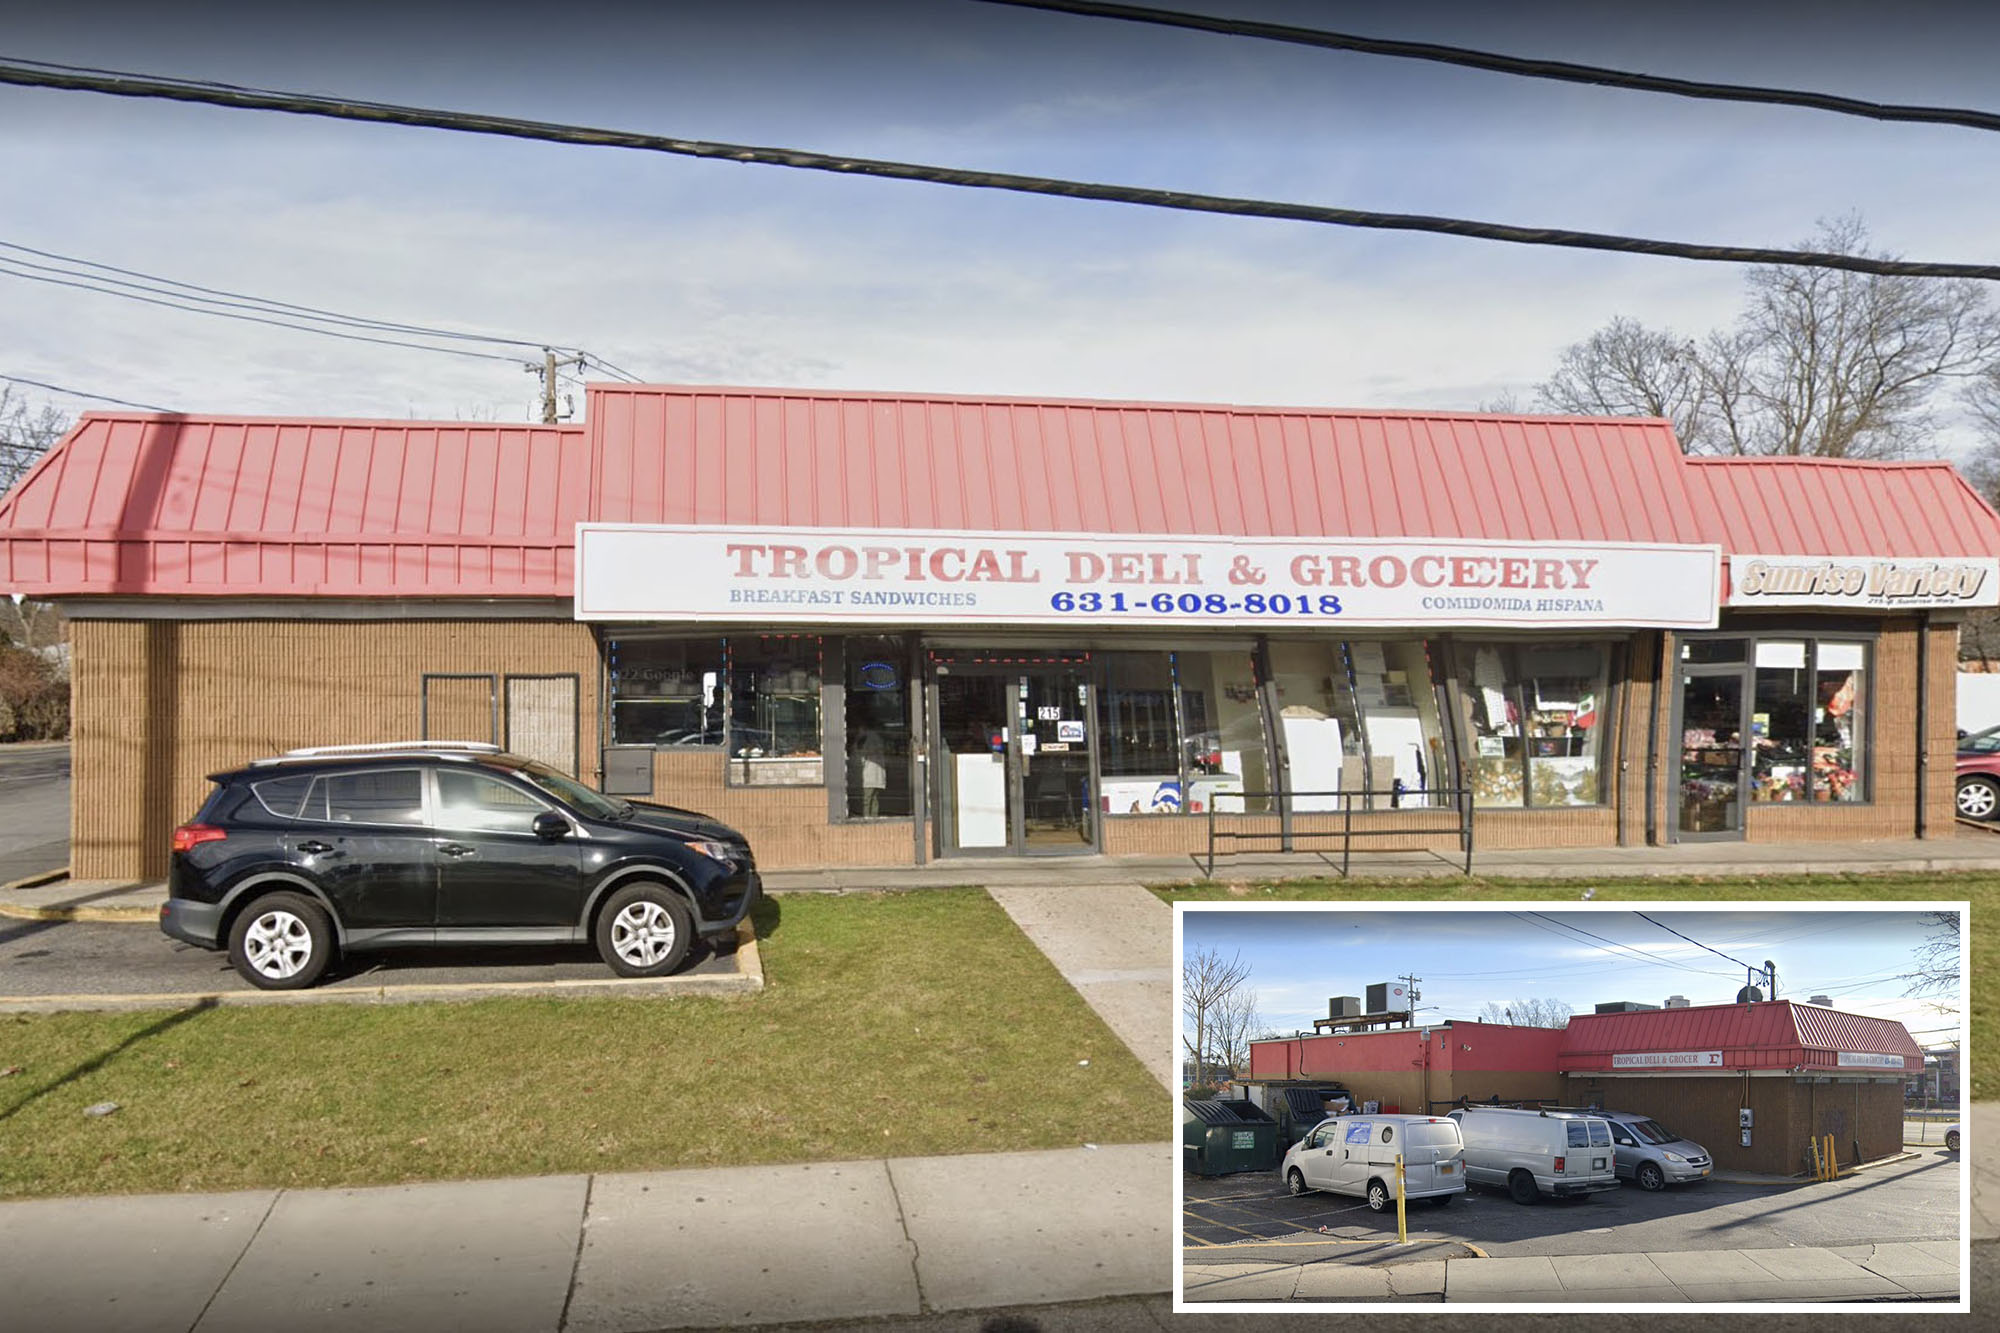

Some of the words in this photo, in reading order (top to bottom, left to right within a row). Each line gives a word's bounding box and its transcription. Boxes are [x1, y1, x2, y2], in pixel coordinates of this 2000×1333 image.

[726, 543, 1041, 584] TROPICAL
[1064, 550, 1203, 585] DELI
[1228, 555, 1267, 587] &
[1741, 560, 1866, 596] Sunrise
[1867, 562, 1987, 600] Variety
[730, 589, 845, 605] BREAKFAST
[850, 591, 978, 607] SANDWICHES
[1050, 591, 1343, 615] 631-608-8018
[1535, 599, 1604, 612] HISPANA
[1040, 708, 1059, 719] 215
[1613, 1056, 1642, 1065] TROPICAL
[1644, 1056, 1660, 1064] DELI
[1669, 1054, 1698, 1064] GROCER
